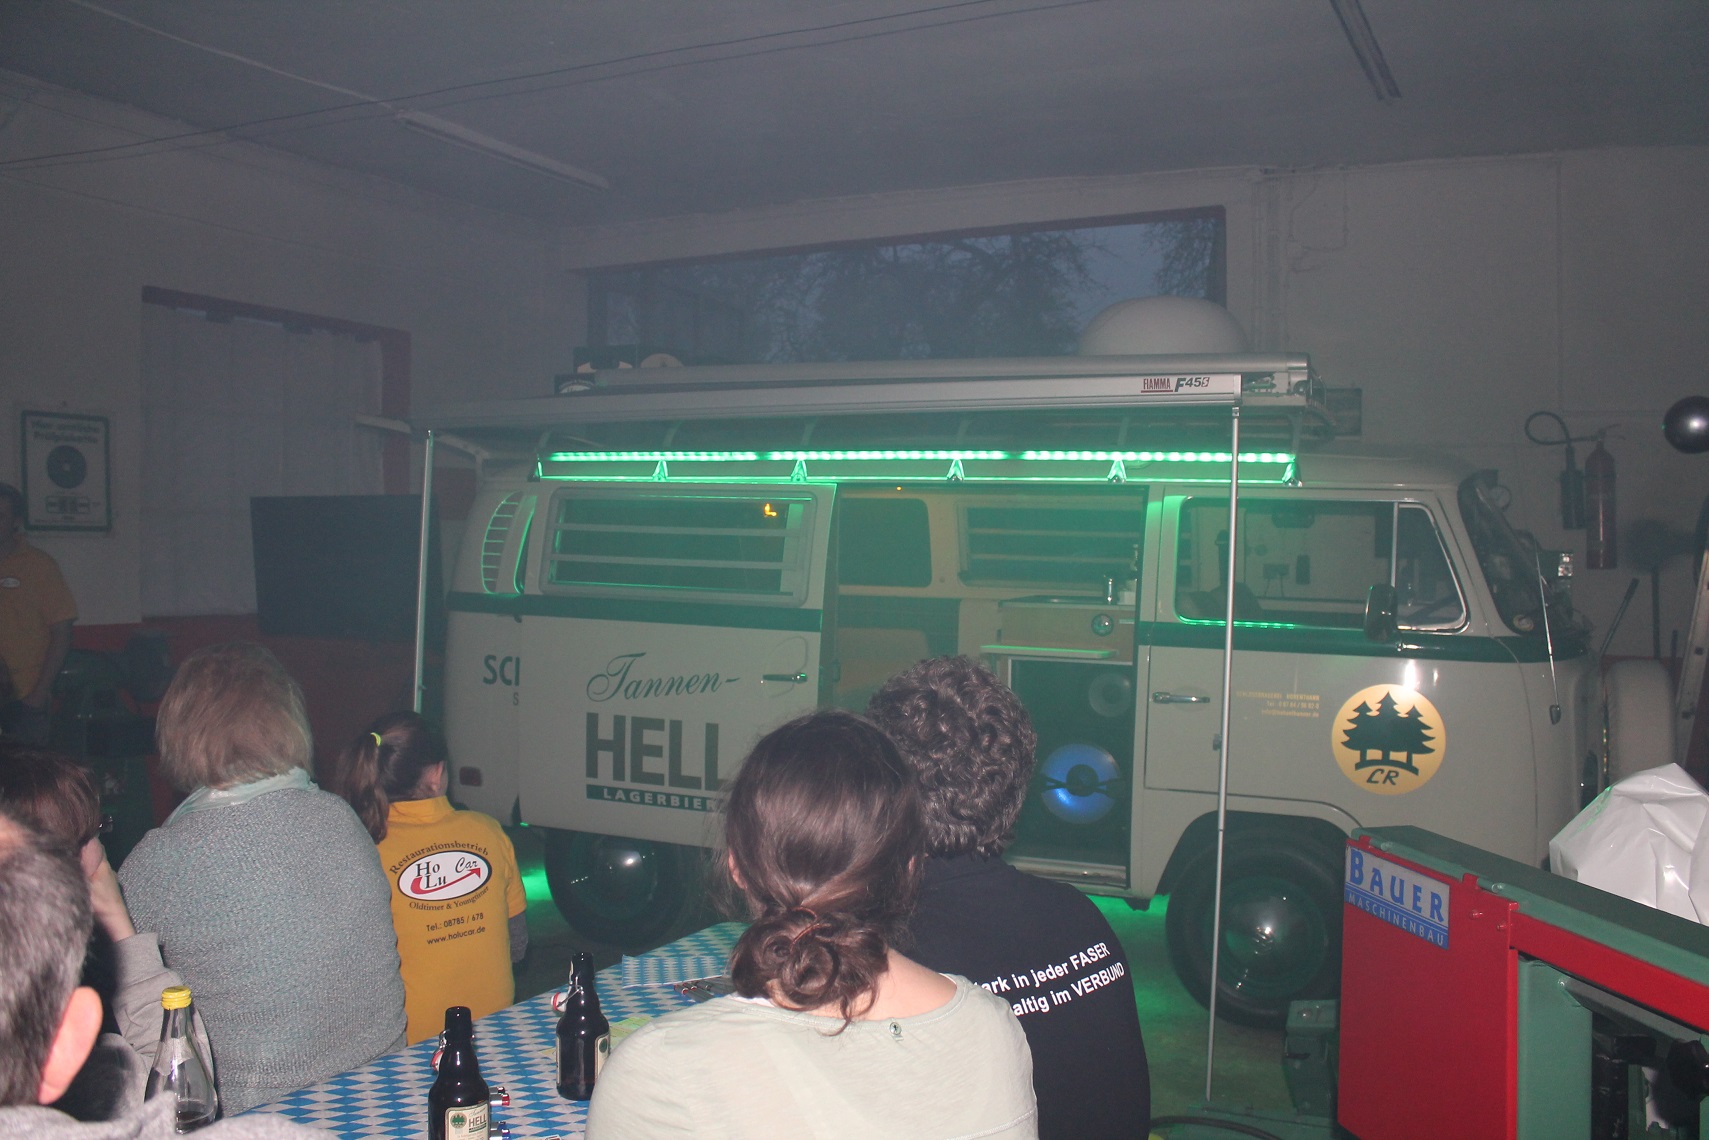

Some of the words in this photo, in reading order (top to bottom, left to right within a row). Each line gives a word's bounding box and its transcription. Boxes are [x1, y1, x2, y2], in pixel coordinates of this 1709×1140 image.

[1143, 378, 1171, 390] FIAMMA
[586, 652, 741, 702] Tannen-
[586, 712, 734, 793] HELL
[1366, 768, 1399, 786] CR
[389, 840, 489, 875] Restaurationsbetrieb
[415, 861, 440, 878] Ho
[455, 857, 479, 873] Car
[425, 874, 447, 889] Lu
[1349, 850, 1444, 923] BAUER
[409, 901, 444, 911] Oldtimer
[453, 886, 489, 908] Youngtimer
[443, 916, 465, 928] 08785
[471, 912, 484, 921] 678
[1348, 892, 1444, 946] MASCHINENBAU
[427, 926, 486, 945] www.holucar.de
[974, 976, 1011, 994] ark
[1011, 973, 1031, 989] in
[1030, 962, 1069, 988] jeder
[1069, 942, 1111, 971] FASER
[1012, 995, 1050, 1017] altig
[1049, 989, 1072, 1006] im
[1071, 961, 1125, 997] VERBUND
